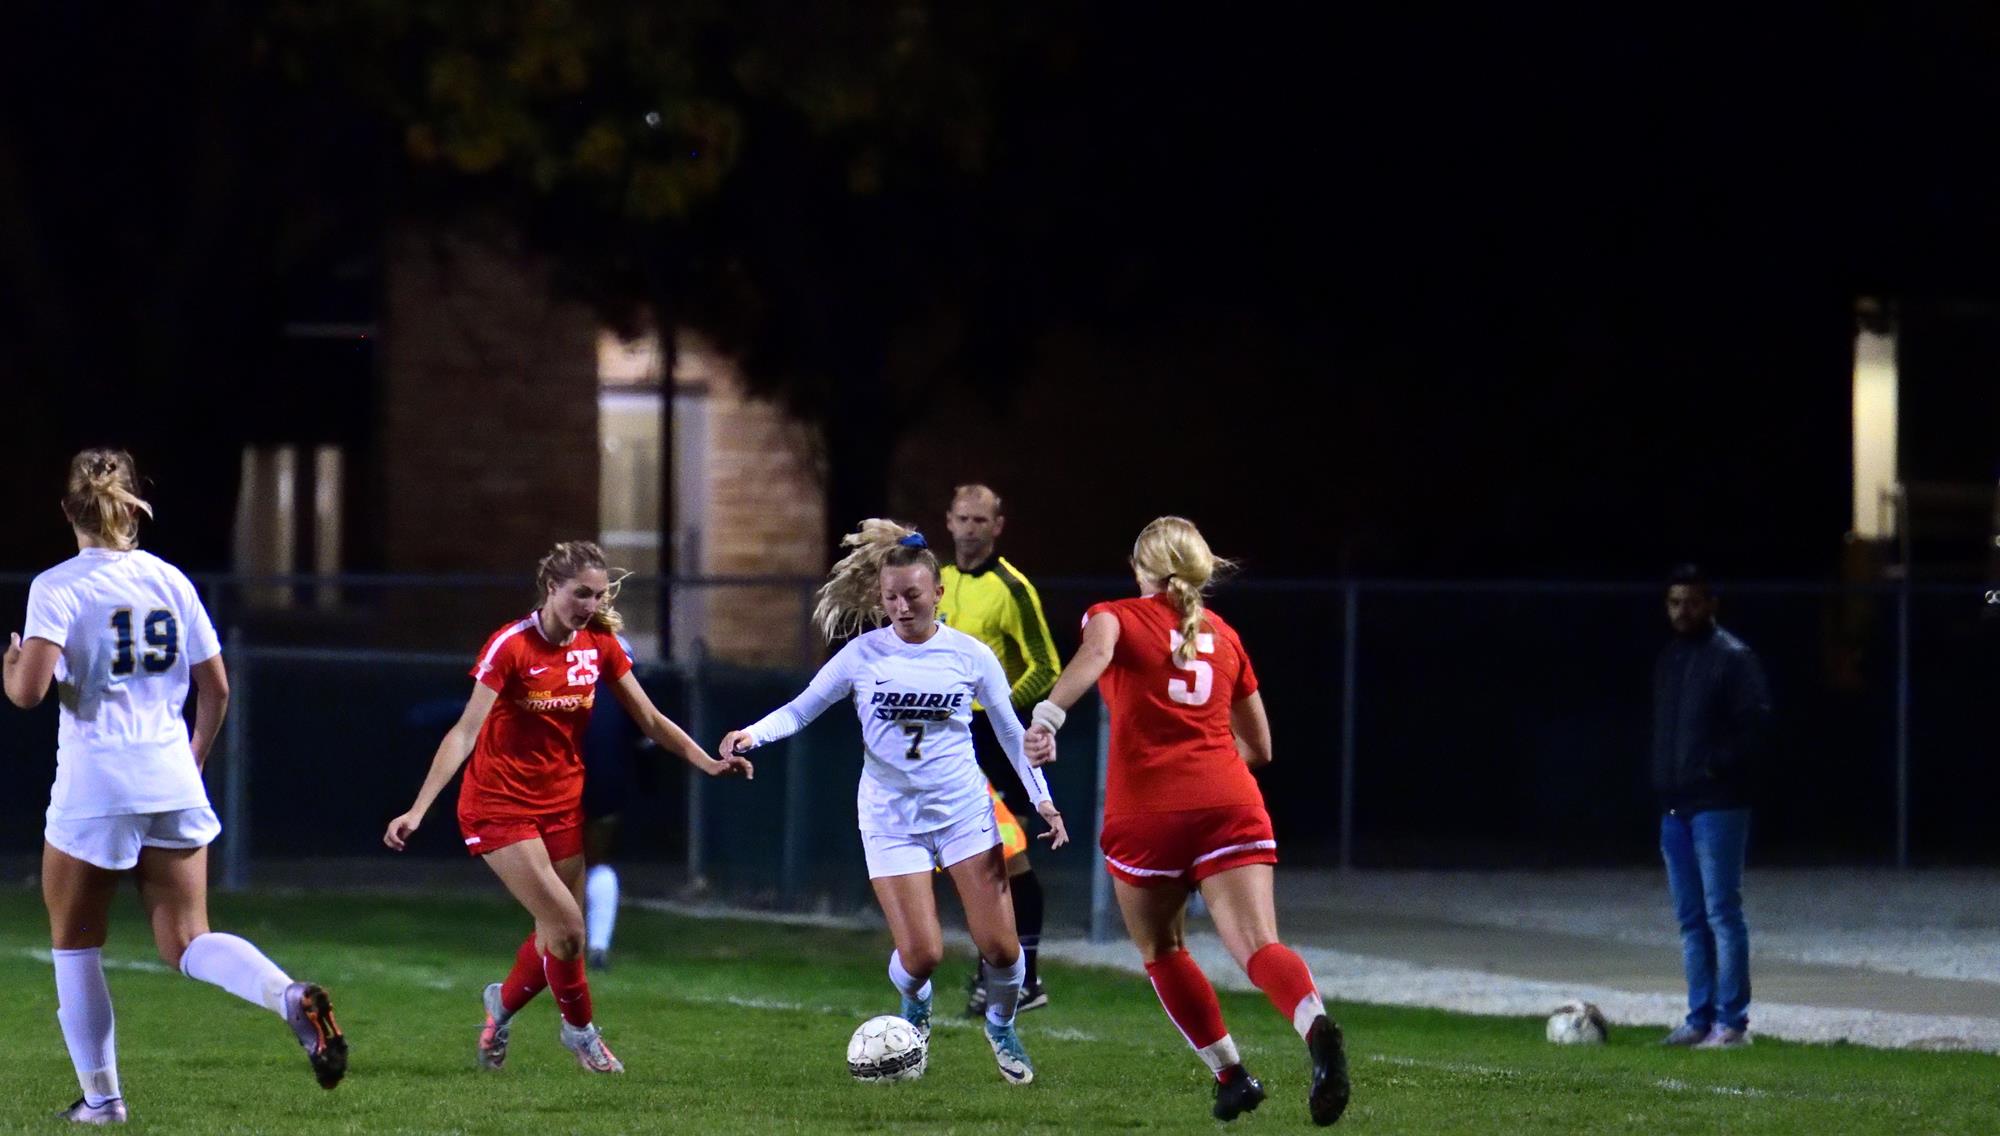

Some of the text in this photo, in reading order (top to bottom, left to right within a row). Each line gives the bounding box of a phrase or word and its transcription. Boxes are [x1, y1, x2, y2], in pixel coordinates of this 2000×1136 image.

[110, 608, 178, 675] 19
[566, 649, 599, 686] 25
[1168, 629, 1214, 706] 5
[870, 692, 964, 707] PRAIRIE
[875, 708, 951, 721] STARS
[903, 724, 924, 760] 7
